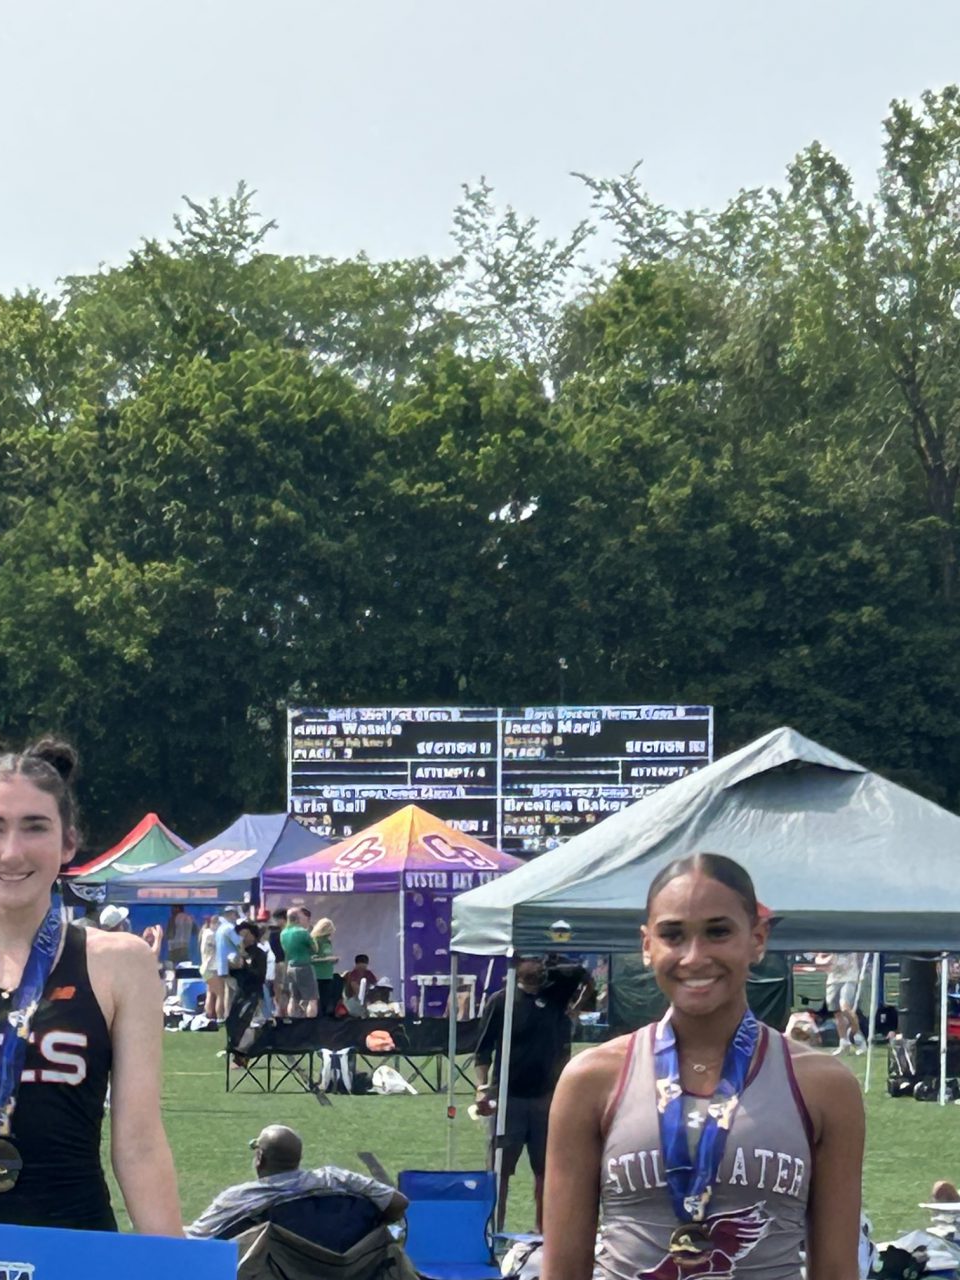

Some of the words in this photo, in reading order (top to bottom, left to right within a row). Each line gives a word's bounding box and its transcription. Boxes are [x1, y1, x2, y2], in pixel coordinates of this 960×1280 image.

[505, 721, 553, 734] Jacob
[417, 742, 476, 754] SECTION
[625, 741, 685, 753] SECTION
[606, 1147, 805, 1197] STILATER
